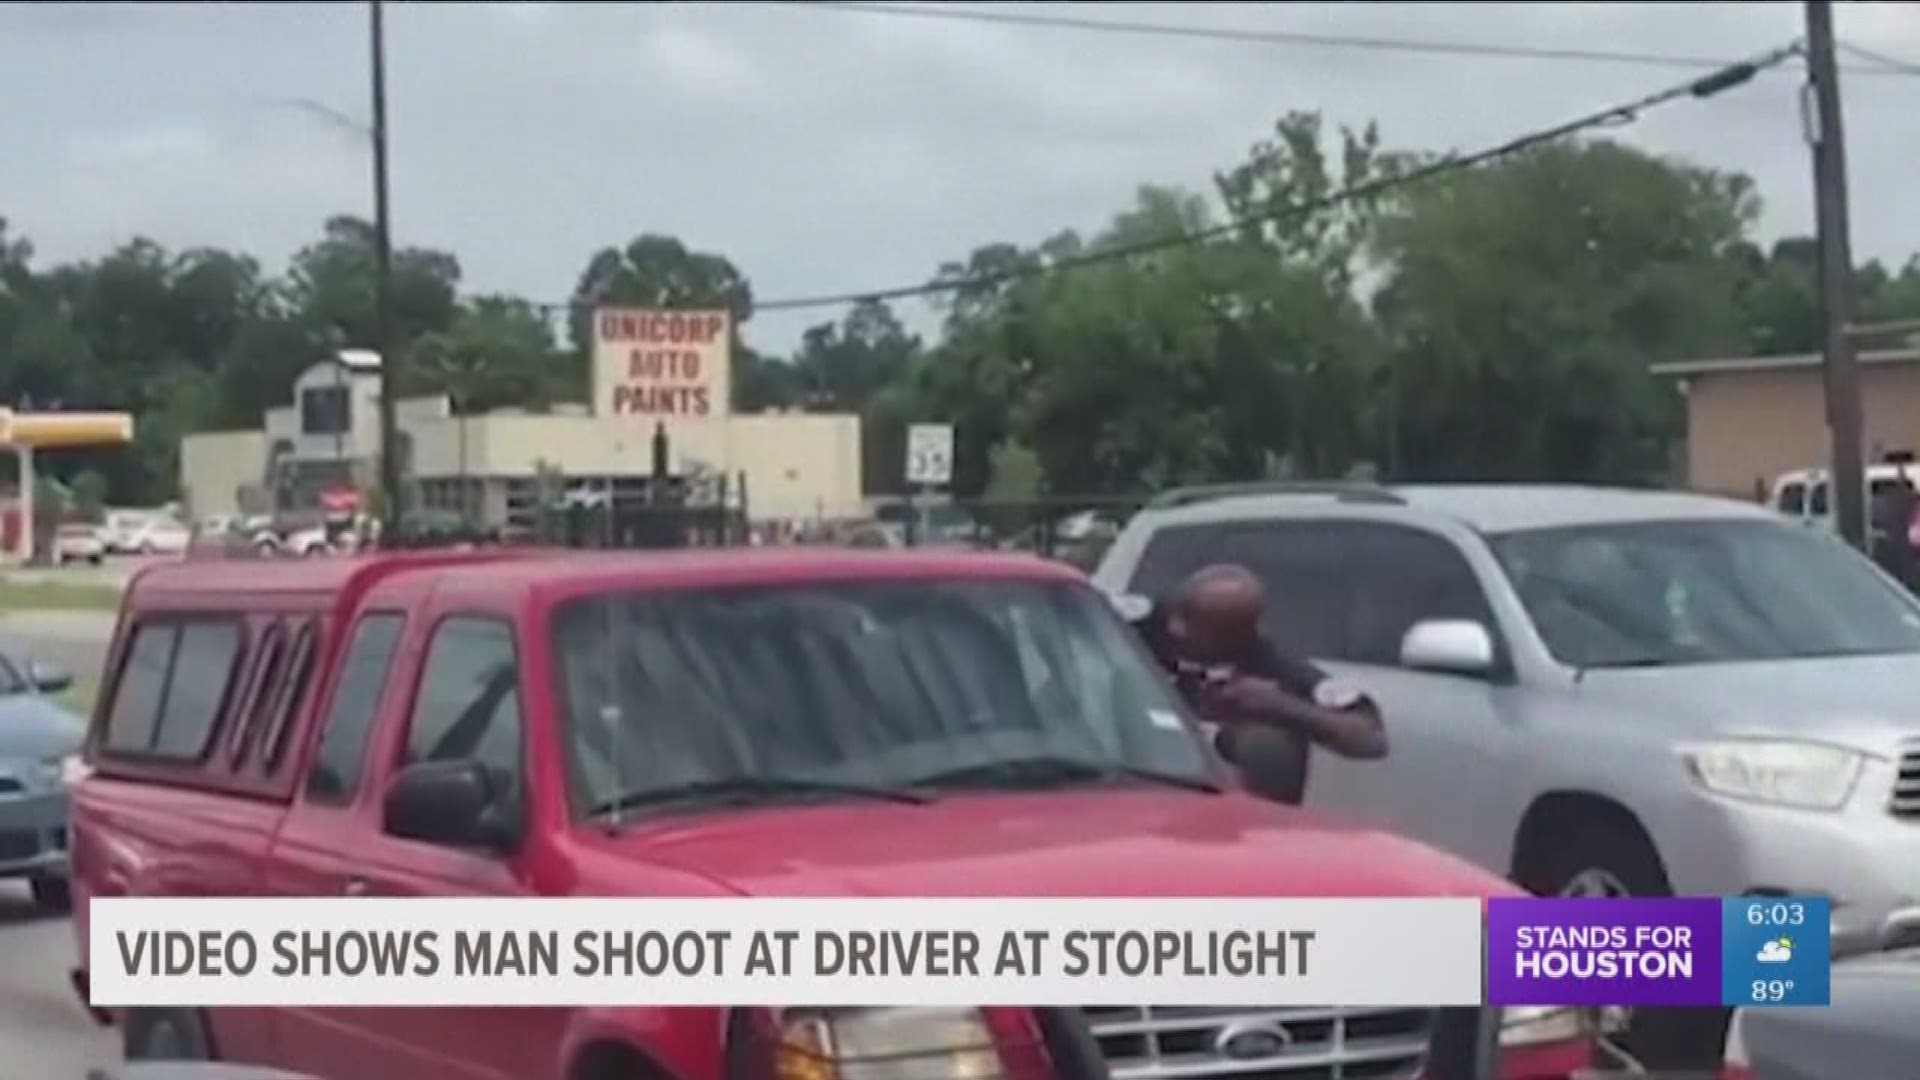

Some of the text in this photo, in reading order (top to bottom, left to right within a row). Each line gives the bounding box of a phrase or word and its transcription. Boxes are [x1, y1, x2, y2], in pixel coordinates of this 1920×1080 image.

[600, 315, 722, 343] UNICORP
[628, 348, 700, 379] AUTO
[612, 384, 711, 415] PAINTS
[909, 450, 949, 475] 35
